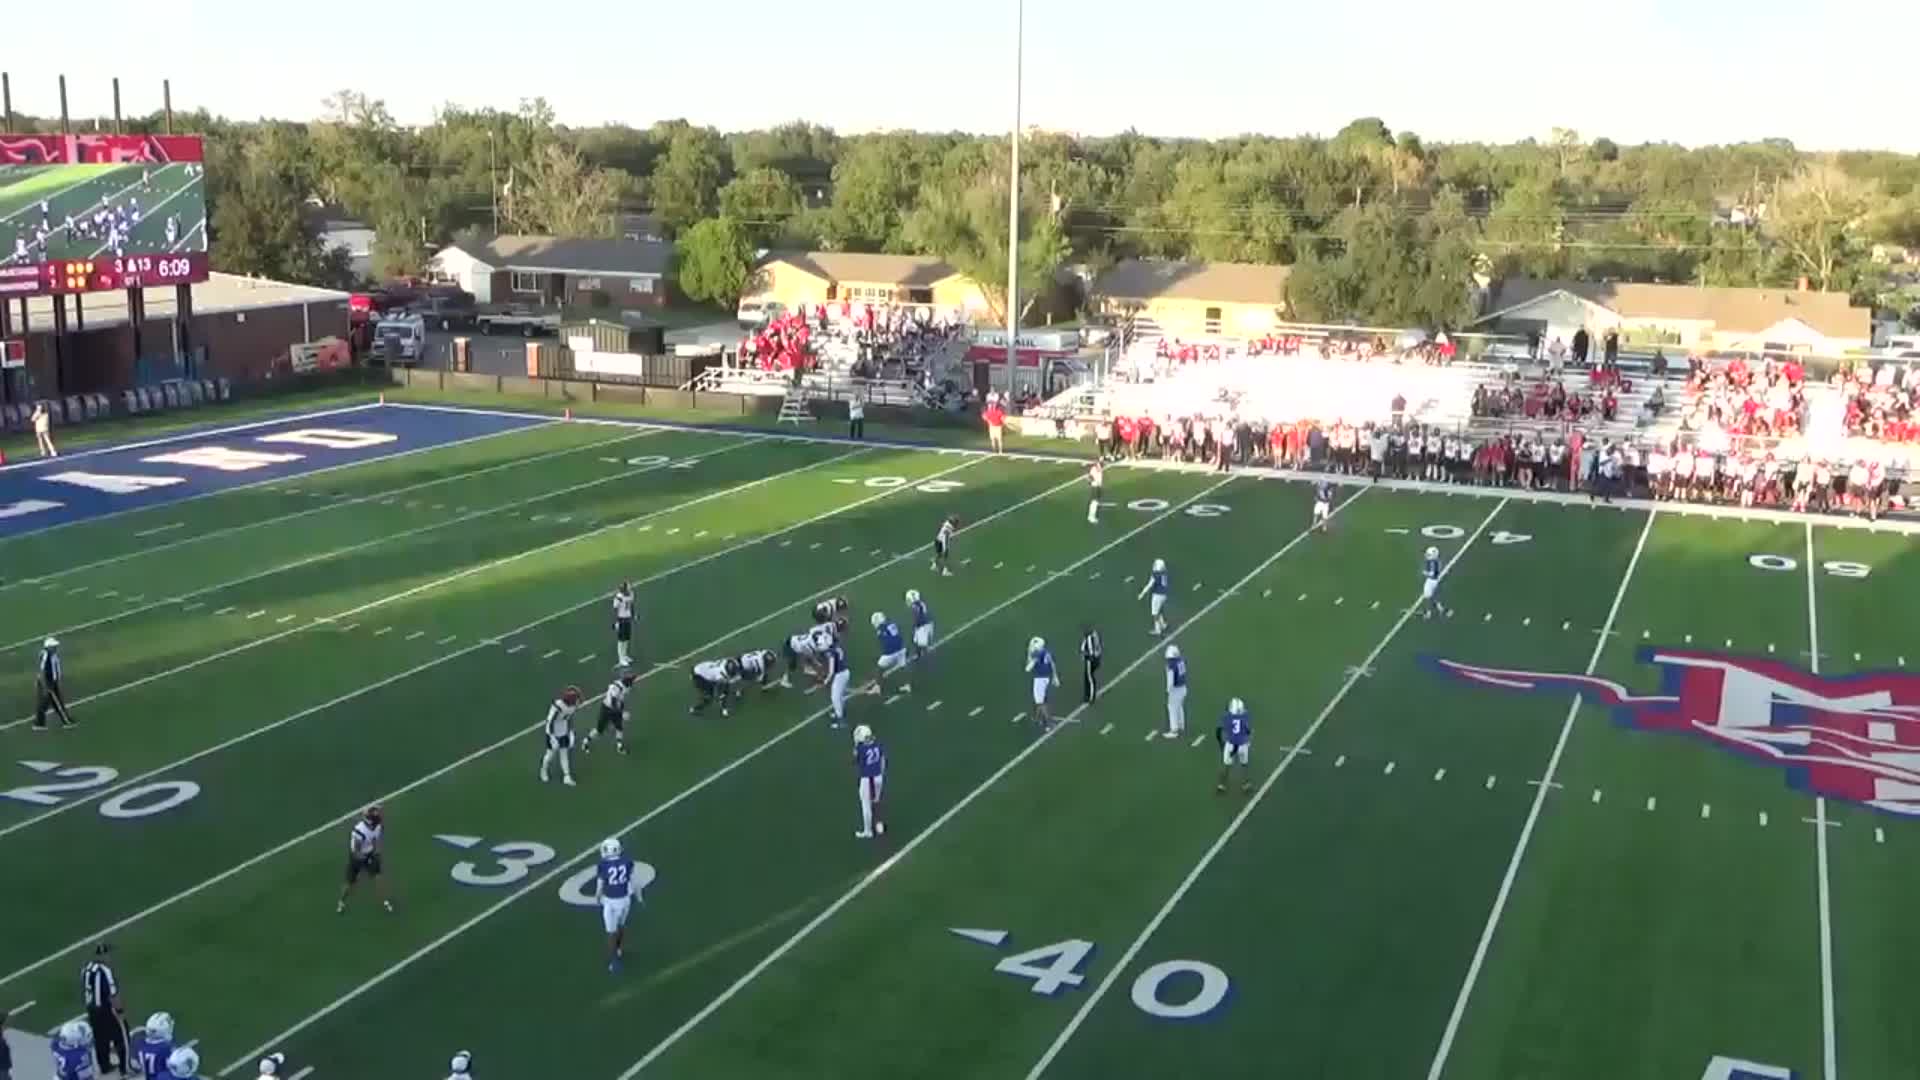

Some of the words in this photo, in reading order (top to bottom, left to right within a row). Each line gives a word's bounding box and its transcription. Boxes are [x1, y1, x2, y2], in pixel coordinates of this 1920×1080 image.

[158, 258, 190, 277] 6:09
[1231, 719, 1241, 734] 3
[0, 766, 200, 818] 20
[607, 864, 628, 886] 22
[994, 938, 1229, 1018] 40
